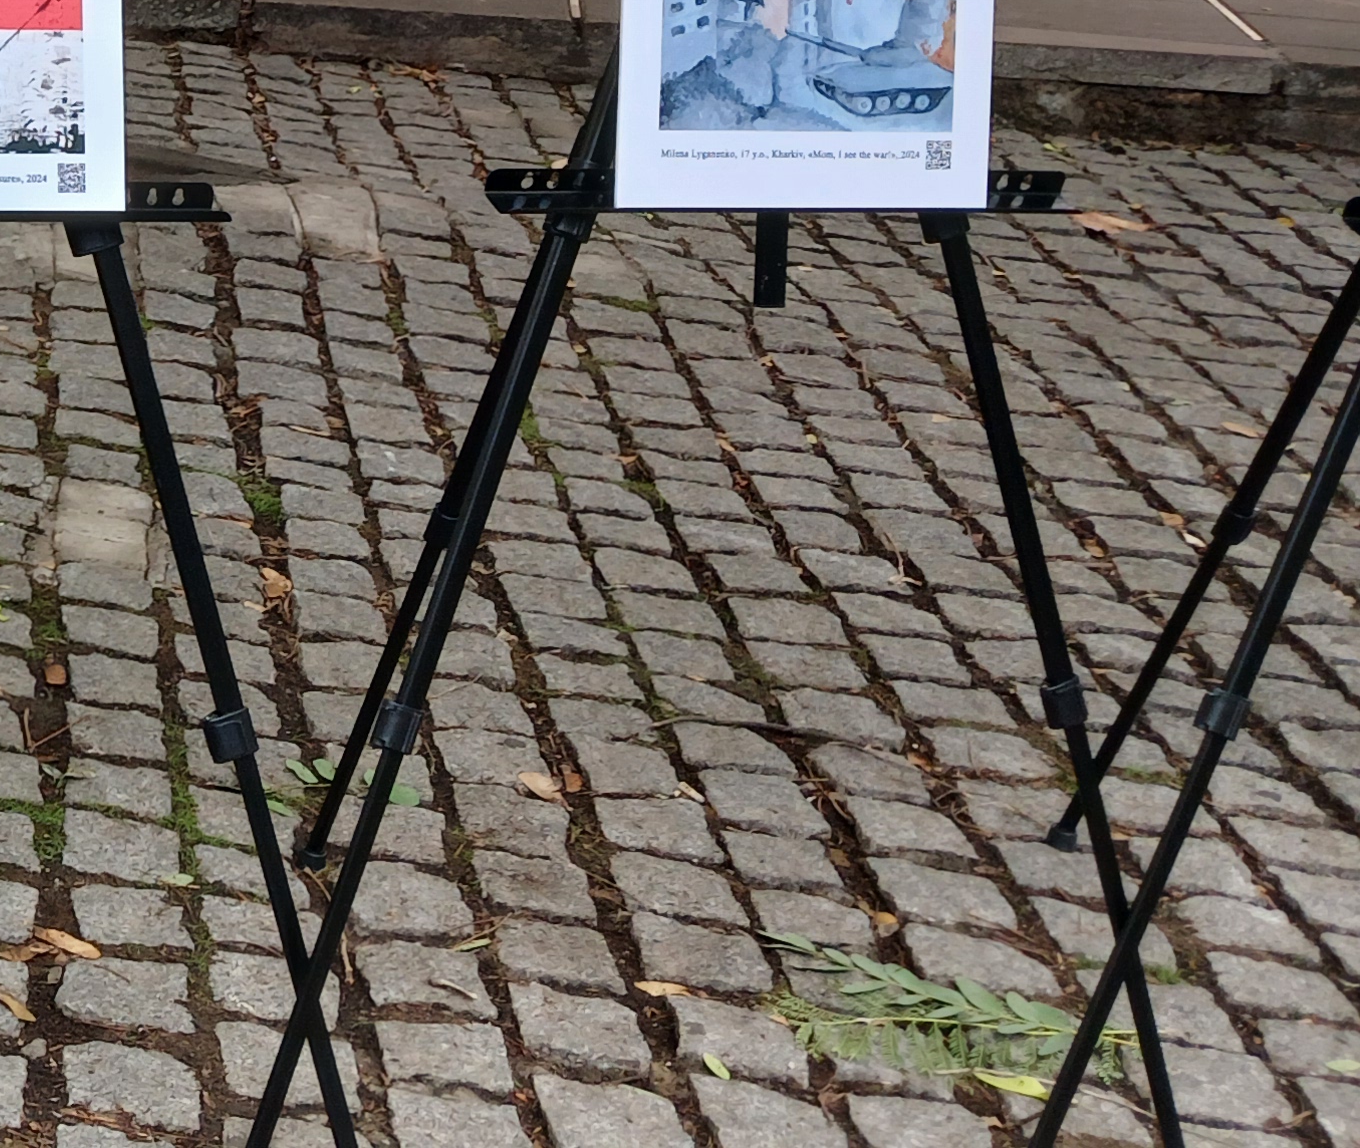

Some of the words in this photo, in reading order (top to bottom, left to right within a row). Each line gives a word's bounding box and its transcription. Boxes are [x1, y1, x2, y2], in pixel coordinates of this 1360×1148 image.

[844, 151, 857, 159] see
[859, 150, 871, 159] the
[26, 174, 47, 183] 2024
